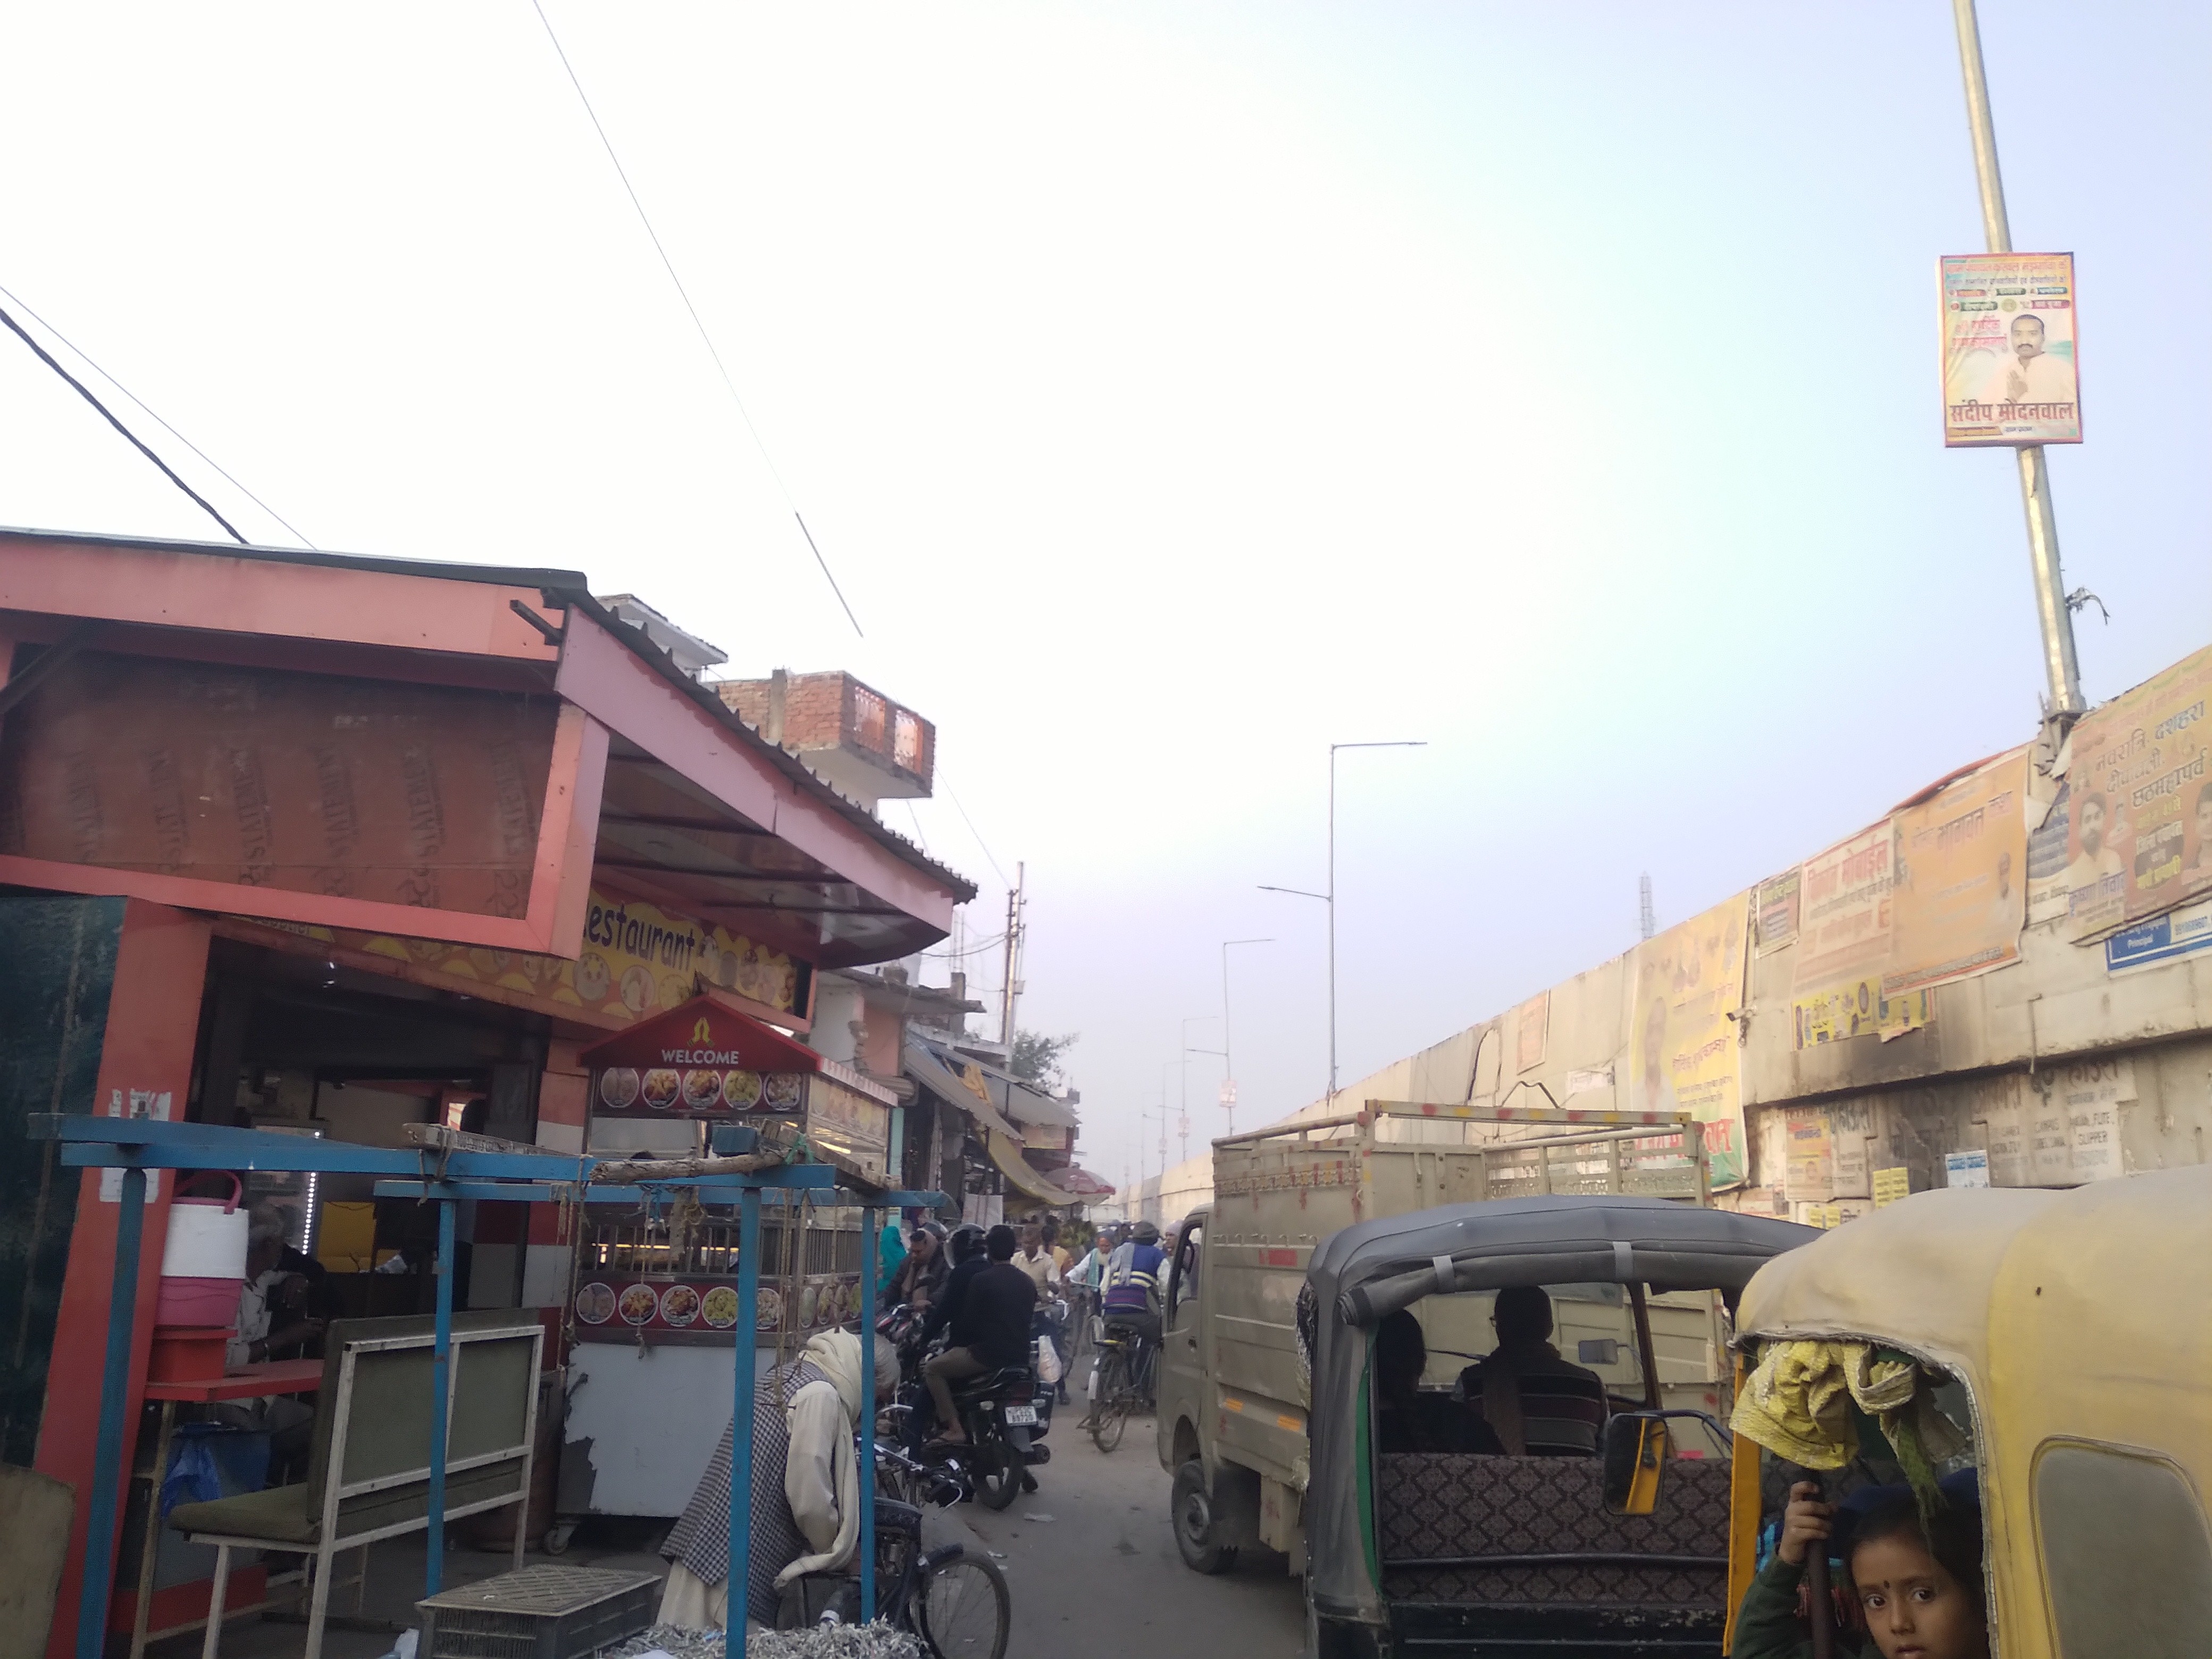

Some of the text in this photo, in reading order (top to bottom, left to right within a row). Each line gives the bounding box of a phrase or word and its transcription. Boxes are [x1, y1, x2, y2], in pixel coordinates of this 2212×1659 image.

[1949, 398, 2074, 422] संदीप मोदनवाल
[583, 903, 695, 971] estaurant
[661, 1049, 739, 1064] WELCOME
